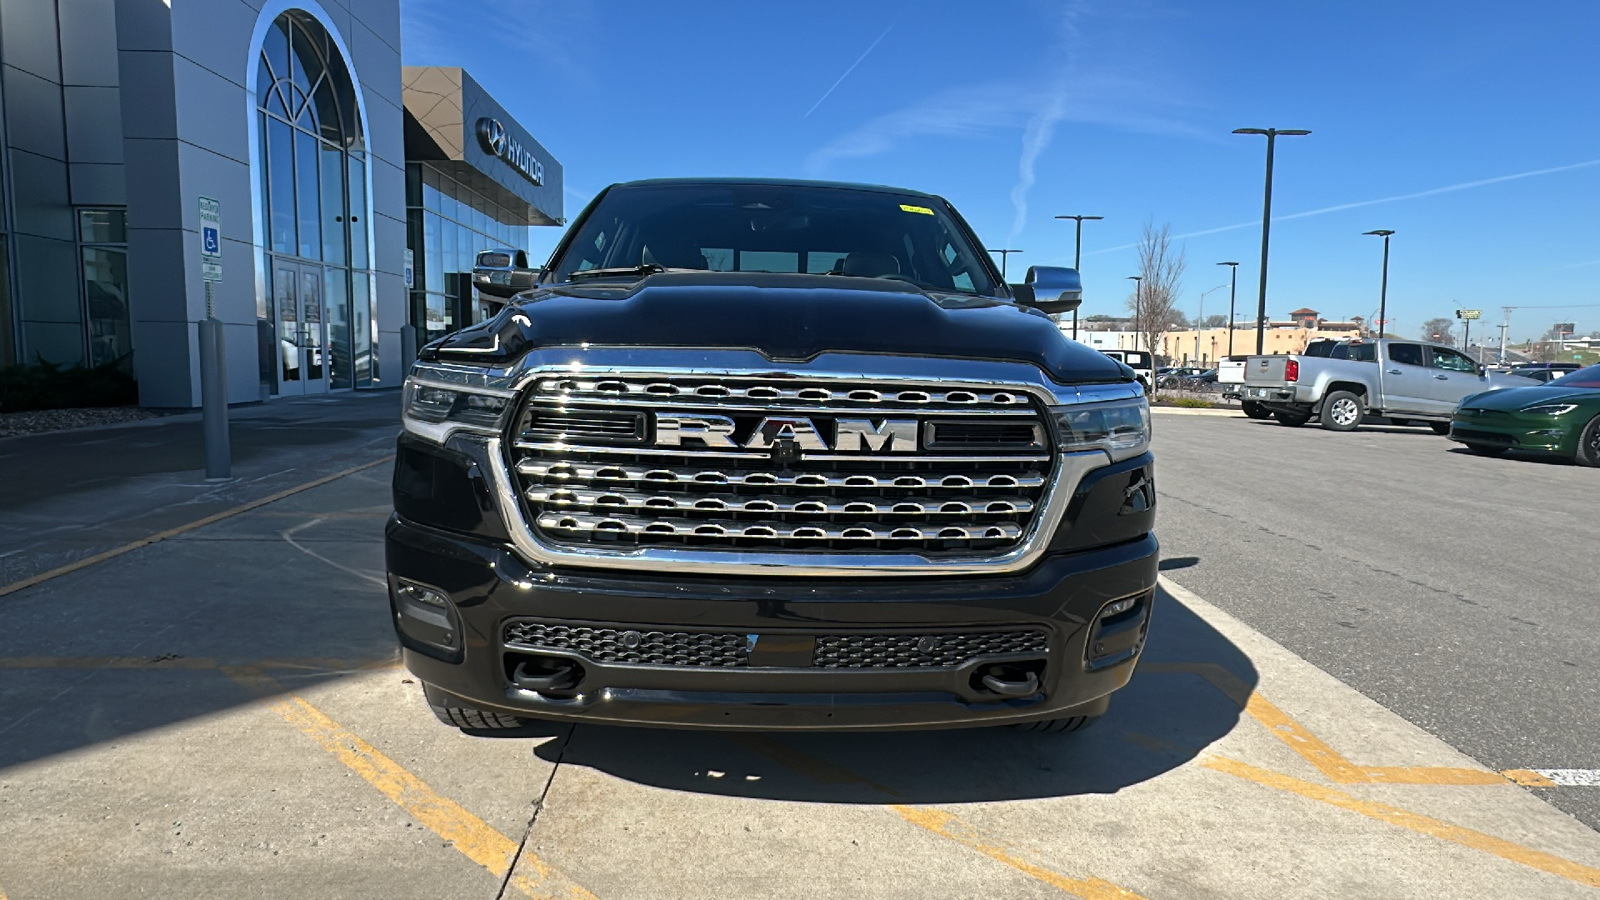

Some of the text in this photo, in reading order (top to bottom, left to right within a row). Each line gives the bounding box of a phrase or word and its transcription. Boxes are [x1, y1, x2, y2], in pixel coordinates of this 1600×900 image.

[508, 135, 544, 186] HYUNDAI
[200, 212, 218, 223] PARKING
[655, 412, 918, 451] RAM
